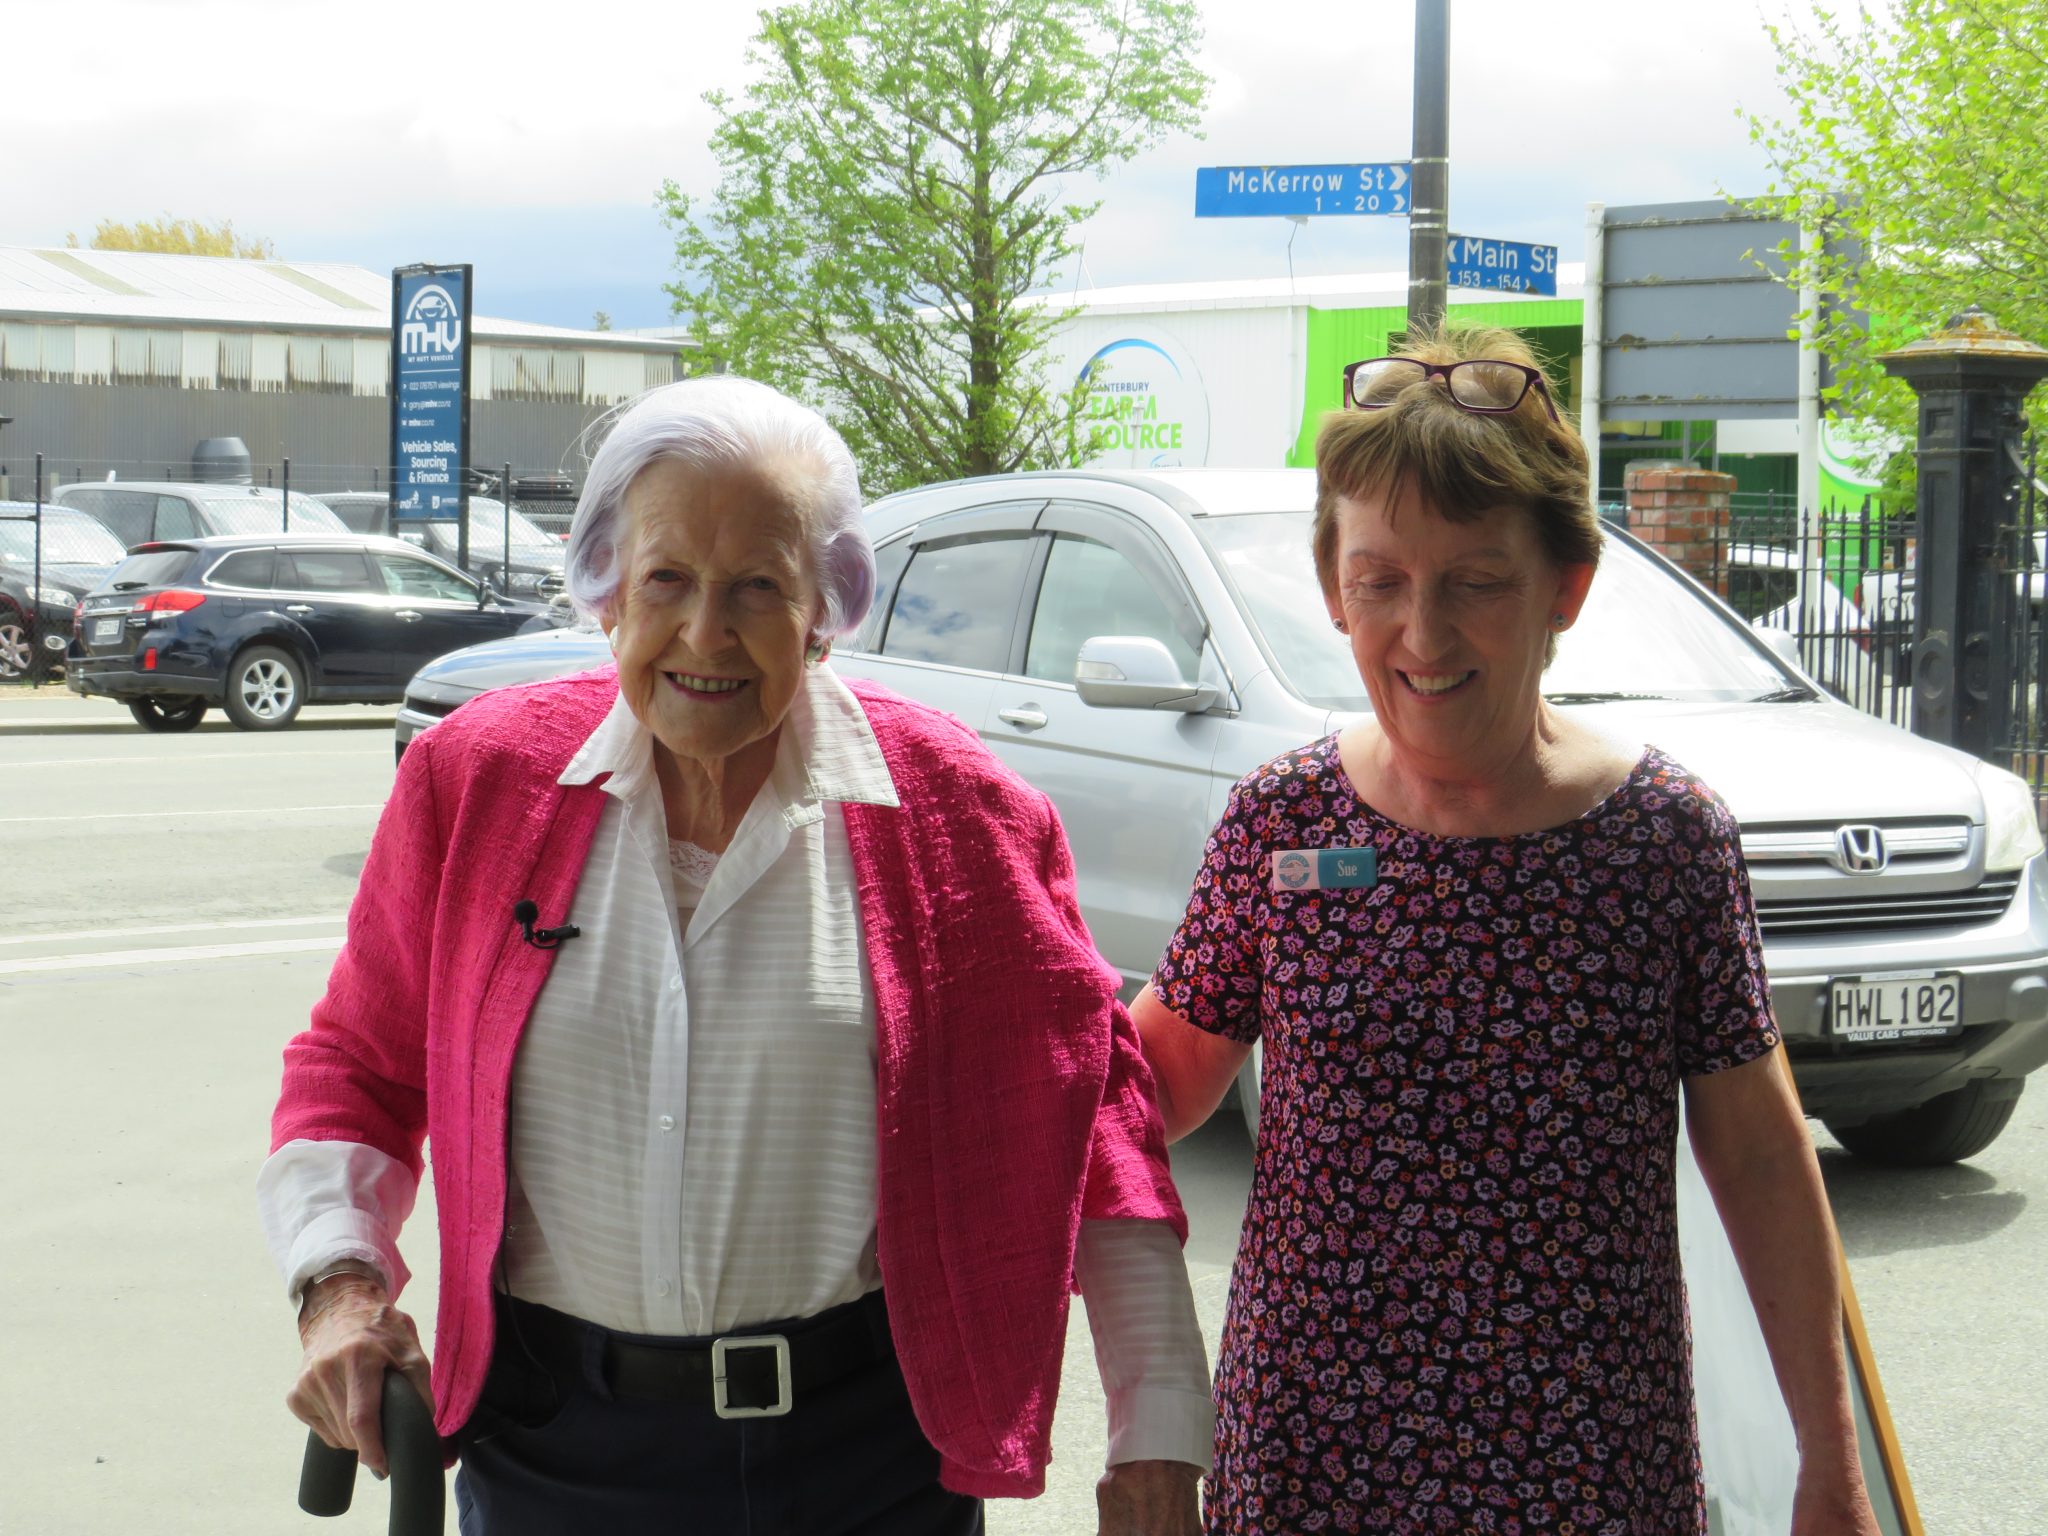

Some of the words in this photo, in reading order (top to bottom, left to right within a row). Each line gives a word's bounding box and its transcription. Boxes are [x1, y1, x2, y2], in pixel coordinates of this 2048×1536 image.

[1227, 170, 1343, 193] McKerrow
[1360, 167, 1385, 191] St
[1315, 197, 1322, 212] 1
[1354, 195, 1380, 211] 20
[1463, 238, 1518, 270] Main
[1530, 245, 1555, 274] St
[1458, 270, 1481, 288] 153
[1498, 274, 1521, 292] 154
[1091, 382, 1150, 393] CANTERBURY
[401, 440, 432, 454] Vehicle
[432, 440, 458, 454] Sales,
[411, 455, 448, 471] Sourcing
[408, 471, 416, 483] &
[416, 470, 449, 483] Finance
[1337, 860, 1358, 877] Sue
[1835, 984, 1956, 1029] HWL102
[1847, 1031, 1875, 1042] VALUE
[1875, 1029, 1900, 1040] CARS
